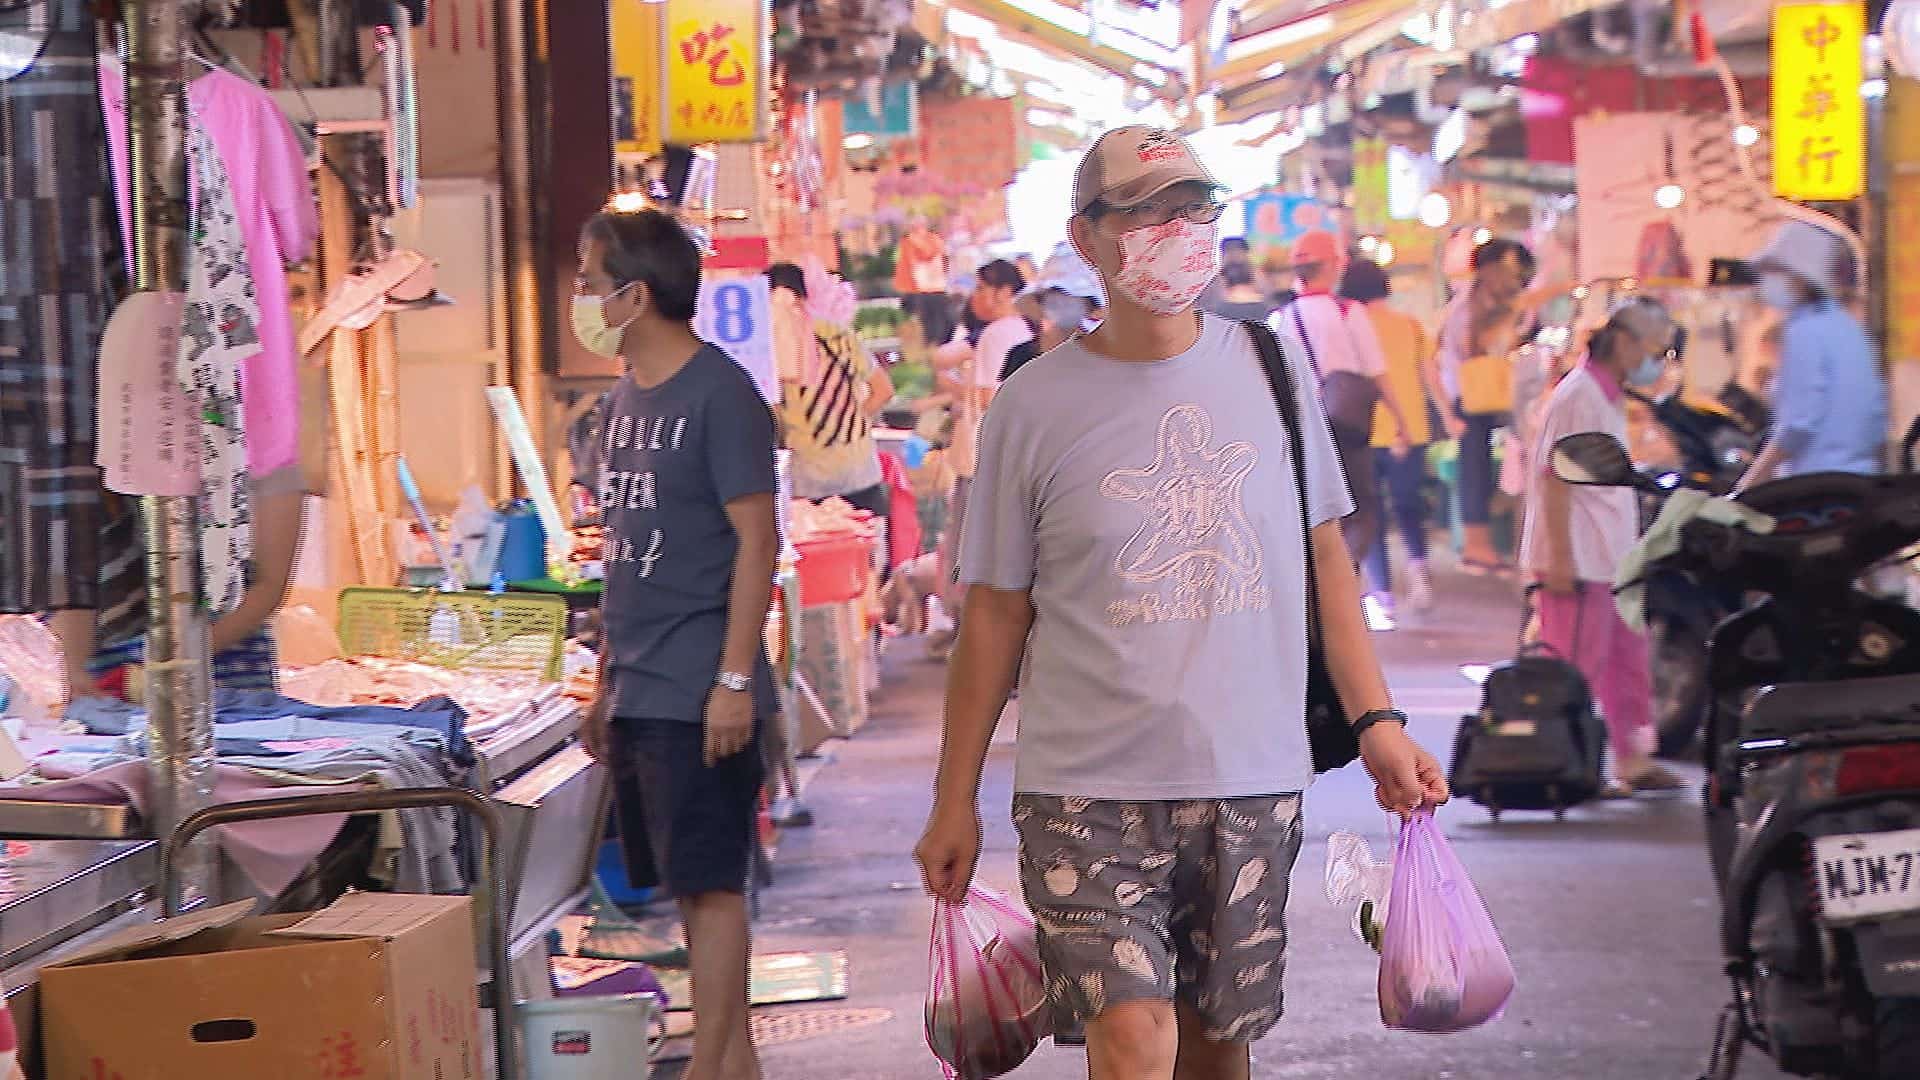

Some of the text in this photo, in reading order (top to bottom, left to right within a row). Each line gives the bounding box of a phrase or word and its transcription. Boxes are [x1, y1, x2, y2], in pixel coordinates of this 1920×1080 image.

[678, 22, 748, 88] 吃
[1797, 15, 1841, 184] 中華行
[712, 283, 756, 343] 8
[1824, 853, 1913, 899] MJM-7
